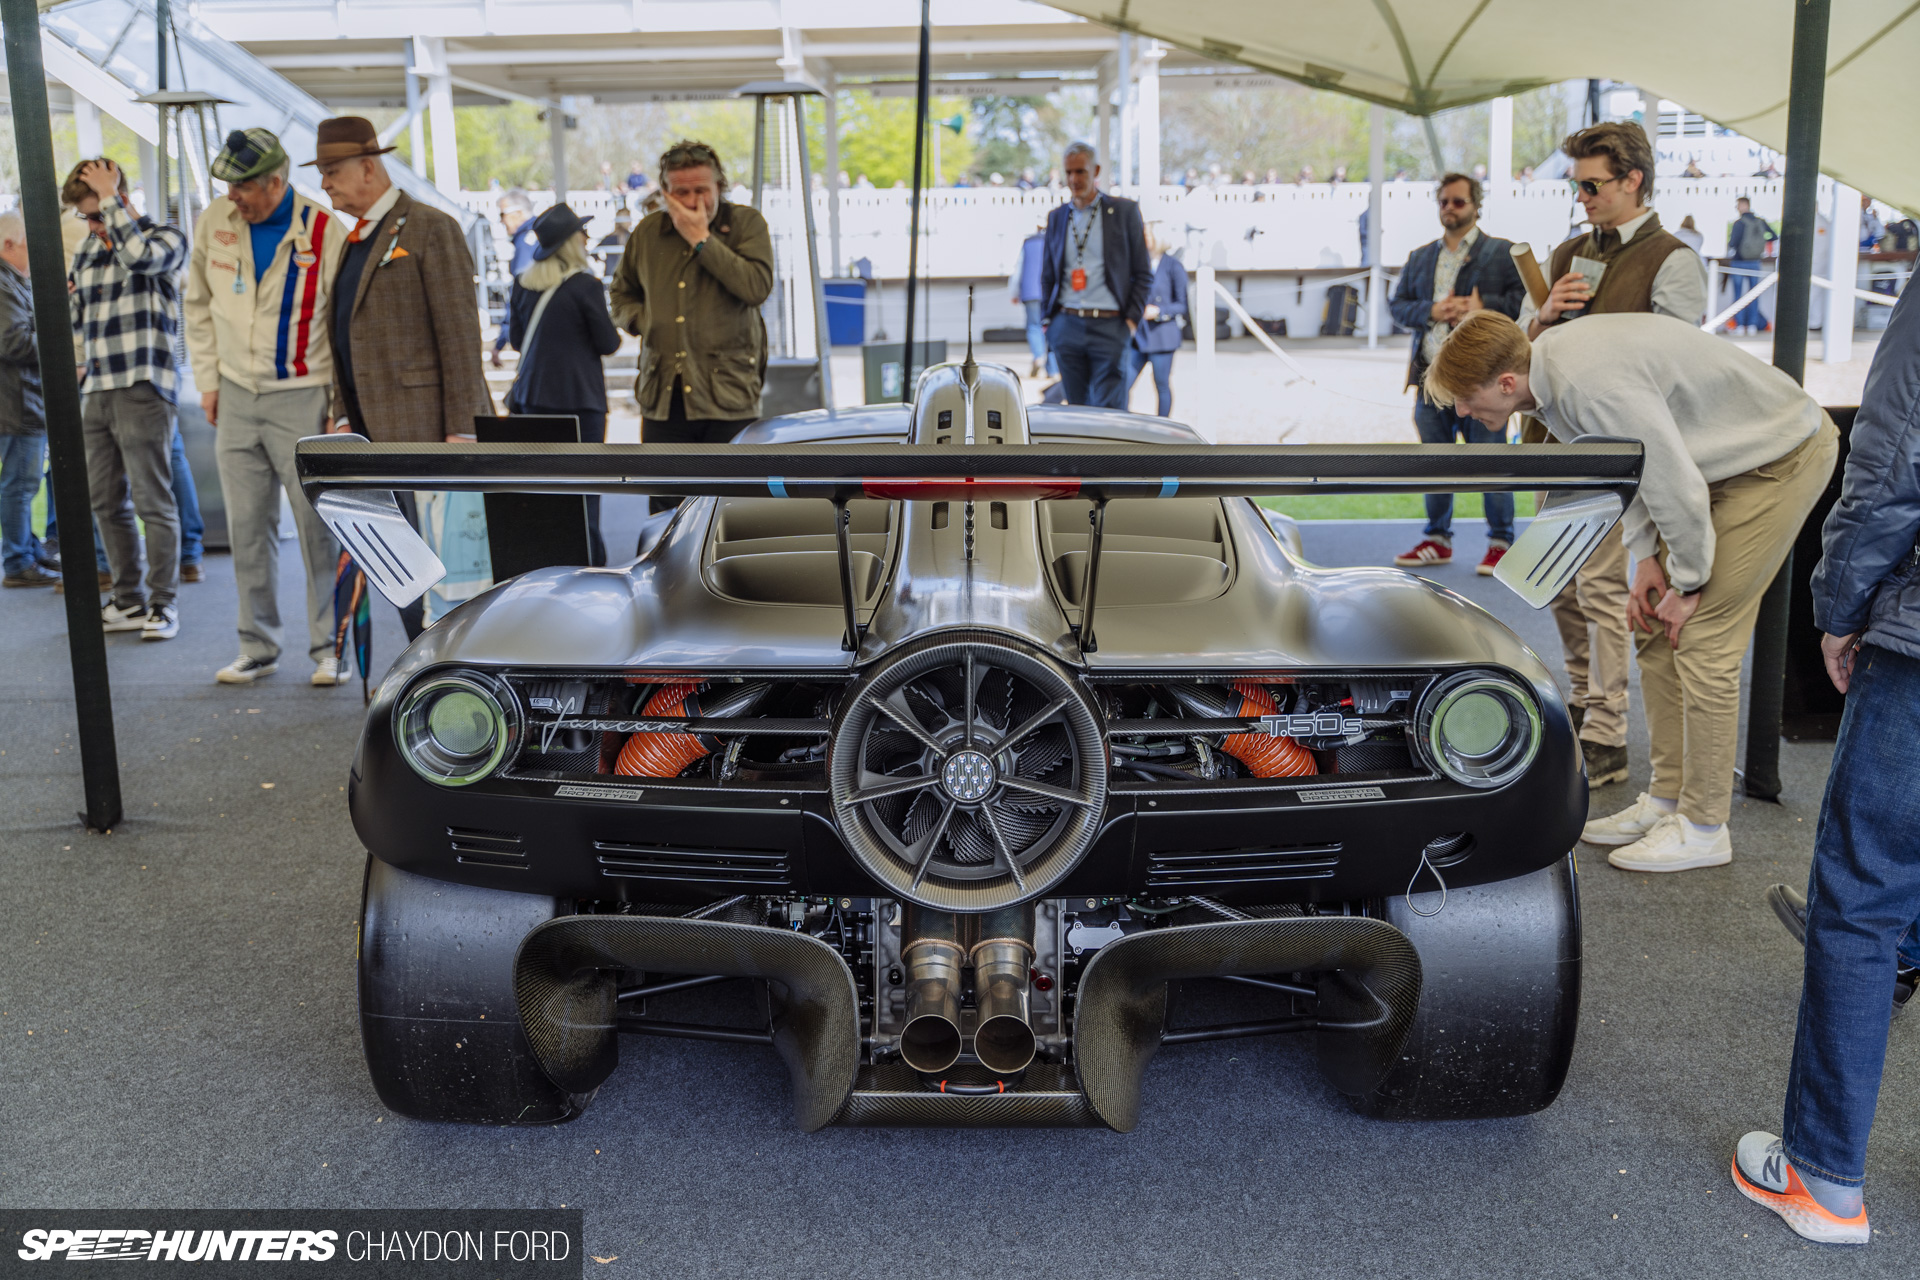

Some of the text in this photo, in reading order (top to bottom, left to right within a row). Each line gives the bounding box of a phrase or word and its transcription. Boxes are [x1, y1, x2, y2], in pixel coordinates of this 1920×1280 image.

[557, 790, 639, 800] PROTOTYPE
[560, 786, 639, 796] EXPERIMENTAL
[1299, 788, 1380, 797] EXPERIMENTAL
[1301, 792, 1384, 801] PROTOTYPE
